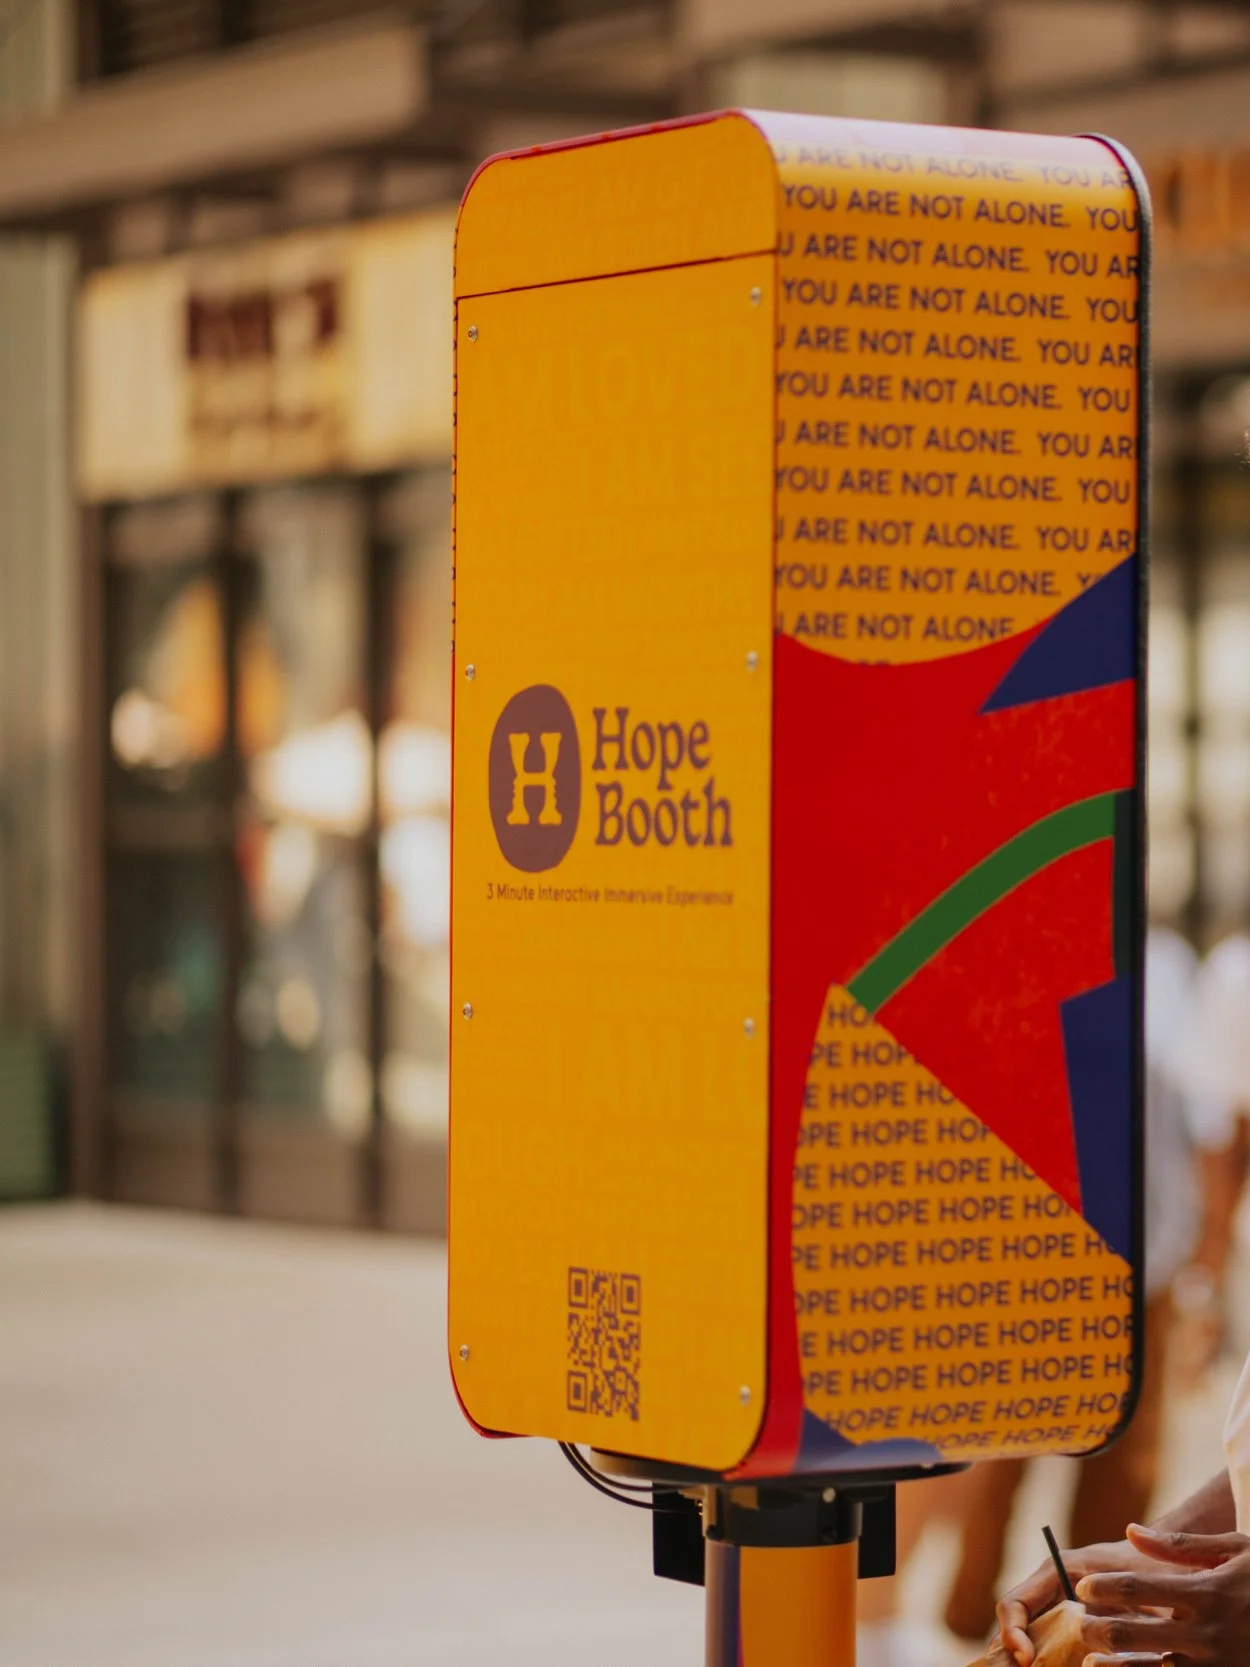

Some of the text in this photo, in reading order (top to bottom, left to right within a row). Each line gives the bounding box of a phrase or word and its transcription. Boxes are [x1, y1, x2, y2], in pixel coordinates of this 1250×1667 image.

[789, 147, 849, 169] ARE
[859, 153, 915, 172] NOT
[1038, 164, 1090, 187] YOU
[783, 186, 1138, 232] YOU ARE NOT ALONE. YOU
[803, 234, 857, 262] ARE
[867, 238, 923, 264] NOT
[932, 245, 1029, 272] ALONE.
[1046, 250, 1098, 277] YOU
[782, 279, 1139, 324] YOU ARE NOT ALONE. YOU
[795, 326, 848, 353] ARE
[859, 330, 914, 355] NOT
[924, 335, 1020, 362] ALONE.
[1038, 340, 1090, 366] YOU
[1099, 344, 1137, 368] AR
[775, 371, 1130, 413] YOU ARE NOT ALONE. YOU
[795, 421, 848, 447] ARE
[858, 424, 914, 449] NOT
[924, 427, 1021, 455] ALONE.
[1038, 432, 1089, 458] YOU
[1098, 435, 1138, 460] AR
[776, 466, 1130, 504] YOU ARE NOT ALONE. YOU
[794, 518, 846, 544] ARE
[858, 520, 913, 545] NOT
[923, 523, 1020, 550] ALONE.
[1037, 526, 1089, 552] YOU
[776, 564, 828, 589] YOU
[837, 566, 889, 591] ARE
[900, 568, 955, 592] NOT
[965, 570, 1061, 597] ALONE.
[793, 613, 846, 641] ARE
[857, 614, 912, 640] NOT
[592, 706, 712, 791] Hope
[507, 732, 562, 826] H
[595, 776, 734, 848] Booth
[487, 883, 495, 900] 3
[497, 884, 535, 902] Minute
[538, 885, 600, 903] Interactive
[830, 1081, 905, 1108] HOPE
[851, 1119, 926, 1146] HOPE
[829, 1161, 904, 1188] HOPE
[915, 1157, 990, 1184] HOPE
[853, 1199, 928, 1226] HOPE
[939, 1195, 1013, 1222] HOPE
[830, 1241, 906, 1268] HOPE
[917, 1237, 992, 1264] HOPE
[1001, 1233, 1075, 1260] HOPE
[850, 1285, 925, 1312] HOPE
[936, 1280, 1010, 1308] HOPE
[1020, 1276, 1093, 1304] HOPE
[827, 1327, 903, 1355] HOPE
[913, 1322, 989, 1350] HOPE
[998, 1317, 1072, 1345] HOPE
[851, 1365, 927, 1392] HOPE
[937, 1359, 1011, 1387] HOPE
[1021, 1354, 1094, 1382] HOPE
[826, 1406, 900, 1433] HOPE
[910, 1401, 985, 1425] HOPE
[994, 1395, 1070, 1420] HOPE
[1003, 1426, 1074, 1443] HOPE
